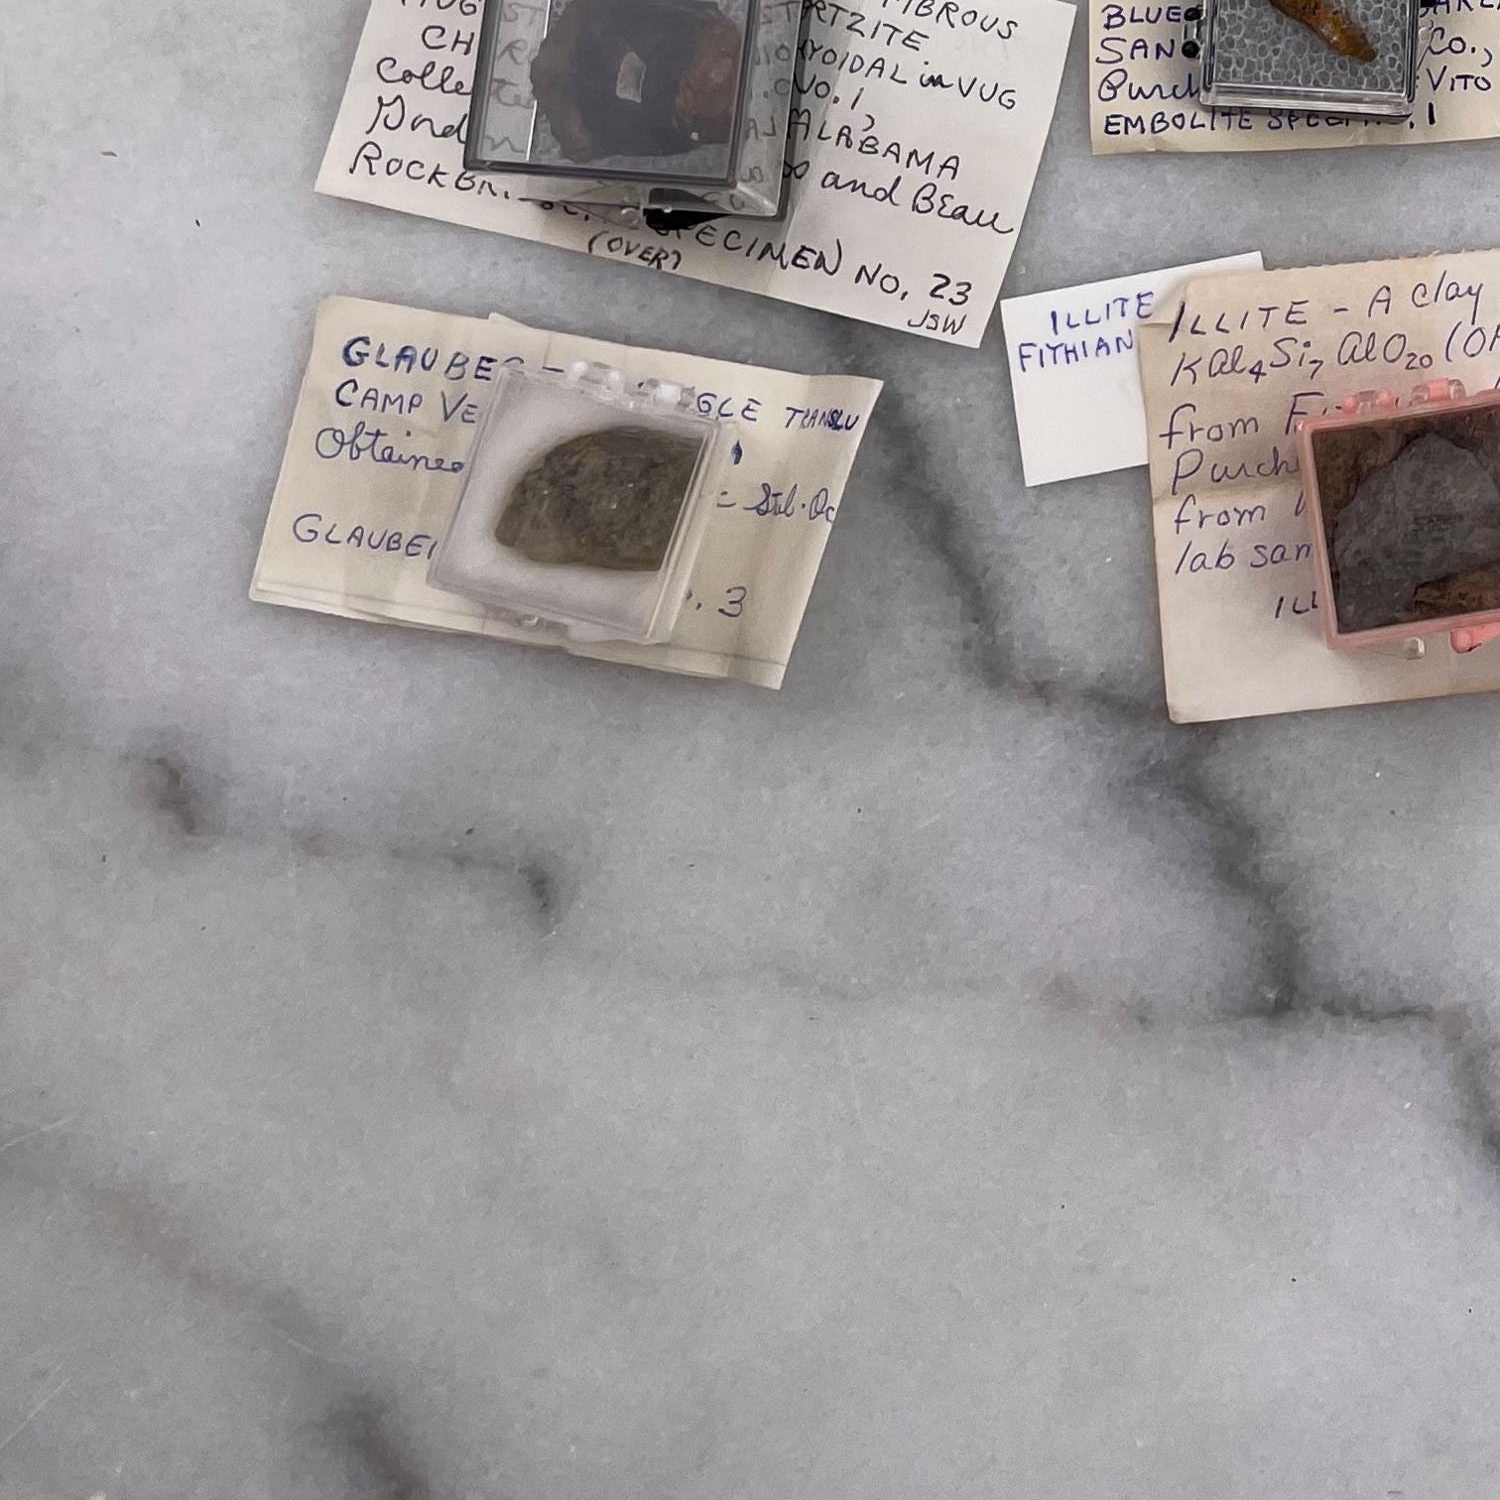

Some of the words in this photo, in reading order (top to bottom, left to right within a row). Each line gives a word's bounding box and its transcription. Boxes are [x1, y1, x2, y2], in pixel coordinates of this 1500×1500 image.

[1101, 4, 1183, 31] BLUE
[1095, 37, 1176, 65] SAN
[421, 25, 475, 56] CH
[786, 107, 961, 181] ALABAMA
[958, 77, 1017, 111] VUG
[376, 56, 472, 96] Colle
[820, 169, 901, 207] and
[928, 271, 973, 306] 23
[1168, 300, 1310, 343] ILLITE
[1368, 285, 1392, 318] A
[1410, 269, 1484, 326] clay
[907, 307, 967, 335] JSW
[1049, 291, 1154, 336] ILLITE
[341, 335, 500, 382] GLAUBE
[1018, 328, 1135, 373] FITHIAN
[334, 378, 424, 415] CAMP
[440, 390, 480, 424] VE
[1159, 403, 1259, 450] from
[1172, 448, 1299, 496] Purch
[1174, 492, 1266, 535] from
[1175, 537, 1236, 576] lab
[717, 585, 748, 618] 3
